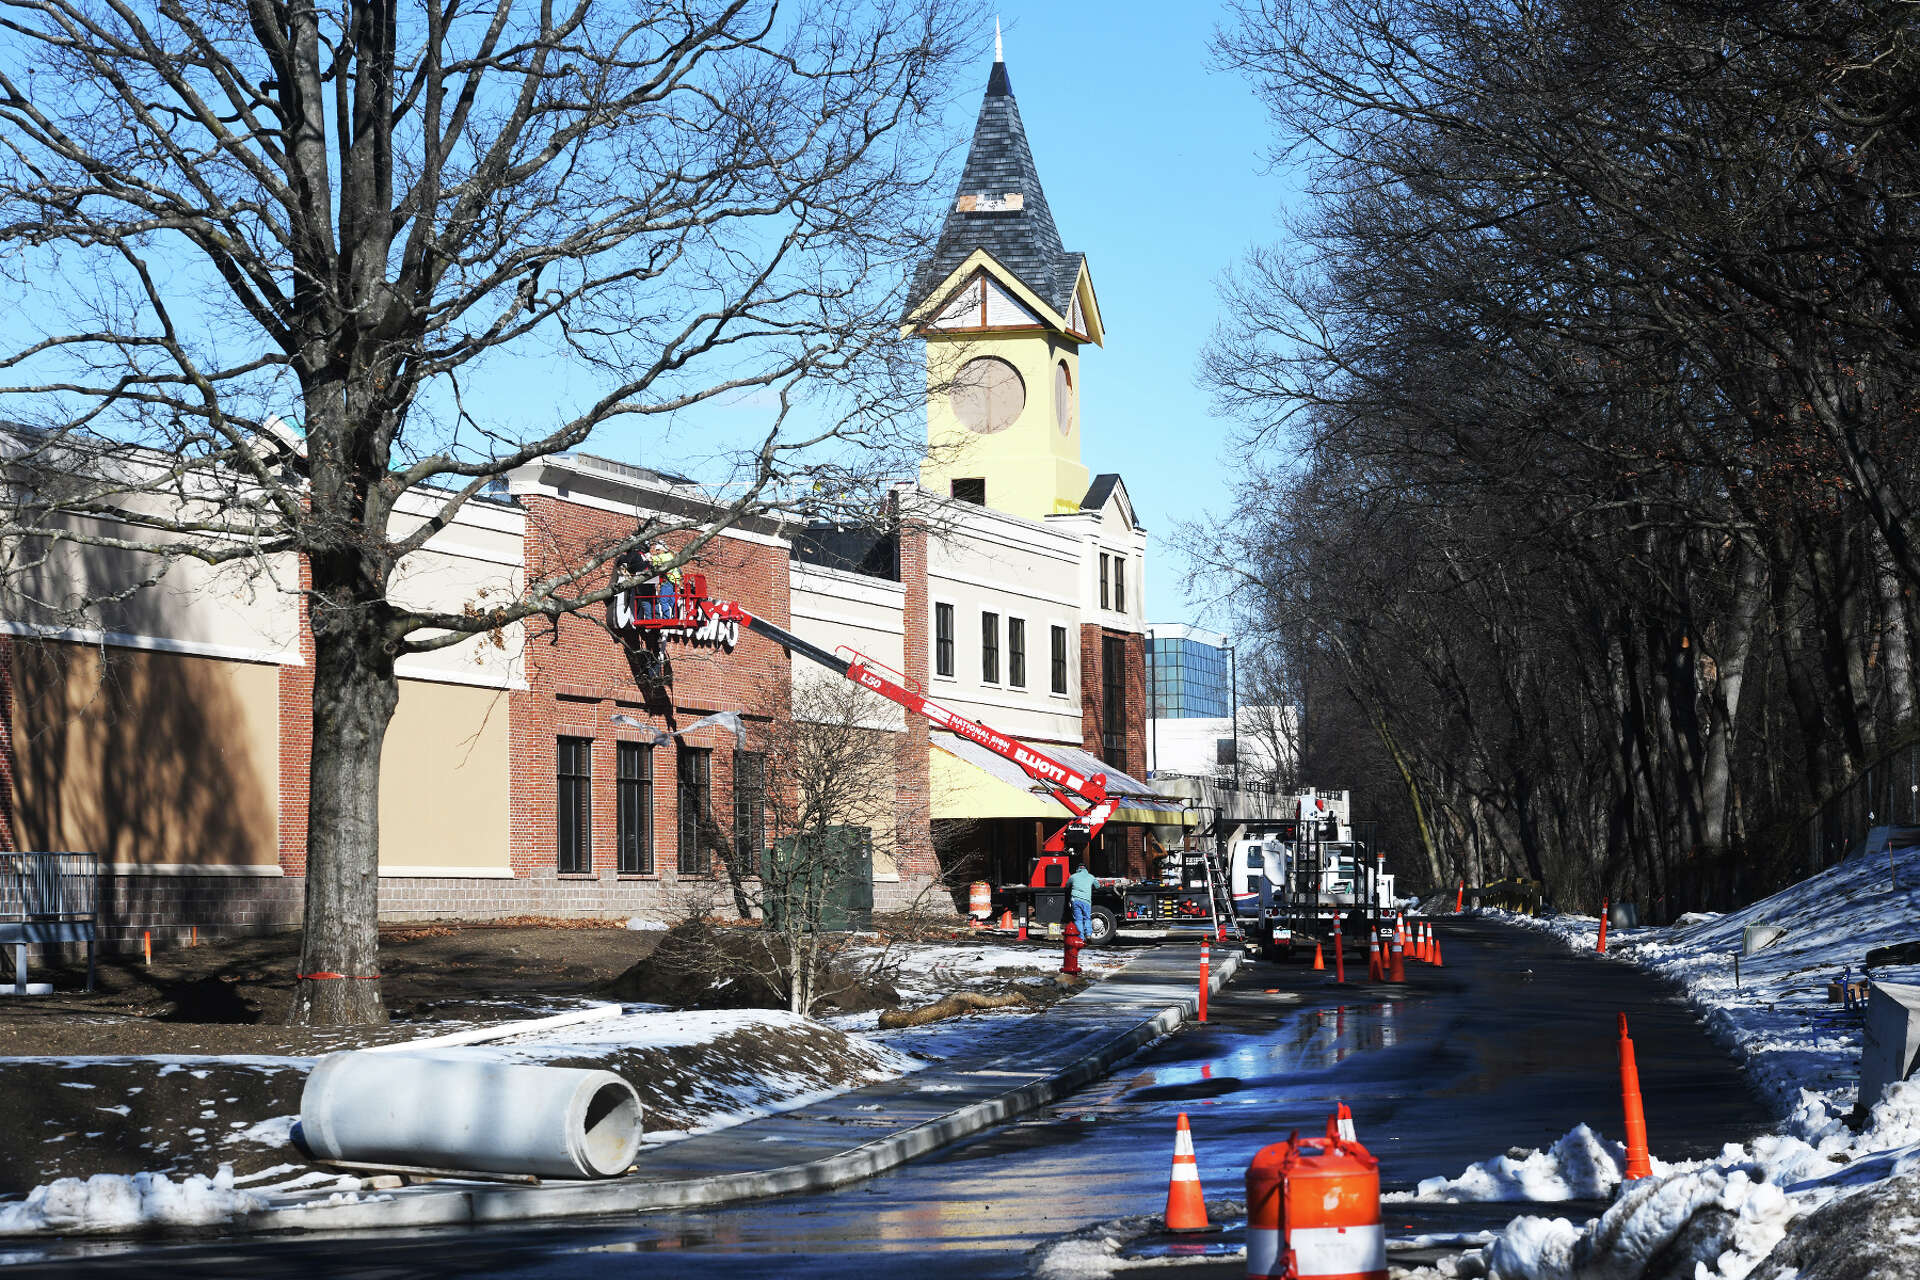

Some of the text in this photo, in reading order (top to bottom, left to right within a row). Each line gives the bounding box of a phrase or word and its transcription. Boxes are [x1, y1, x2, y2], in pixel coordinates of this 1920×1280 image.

[951, 715, 1011, 750] NATIONAL SIGN
[1014, 747, 1066, 781] ELLIOTT
